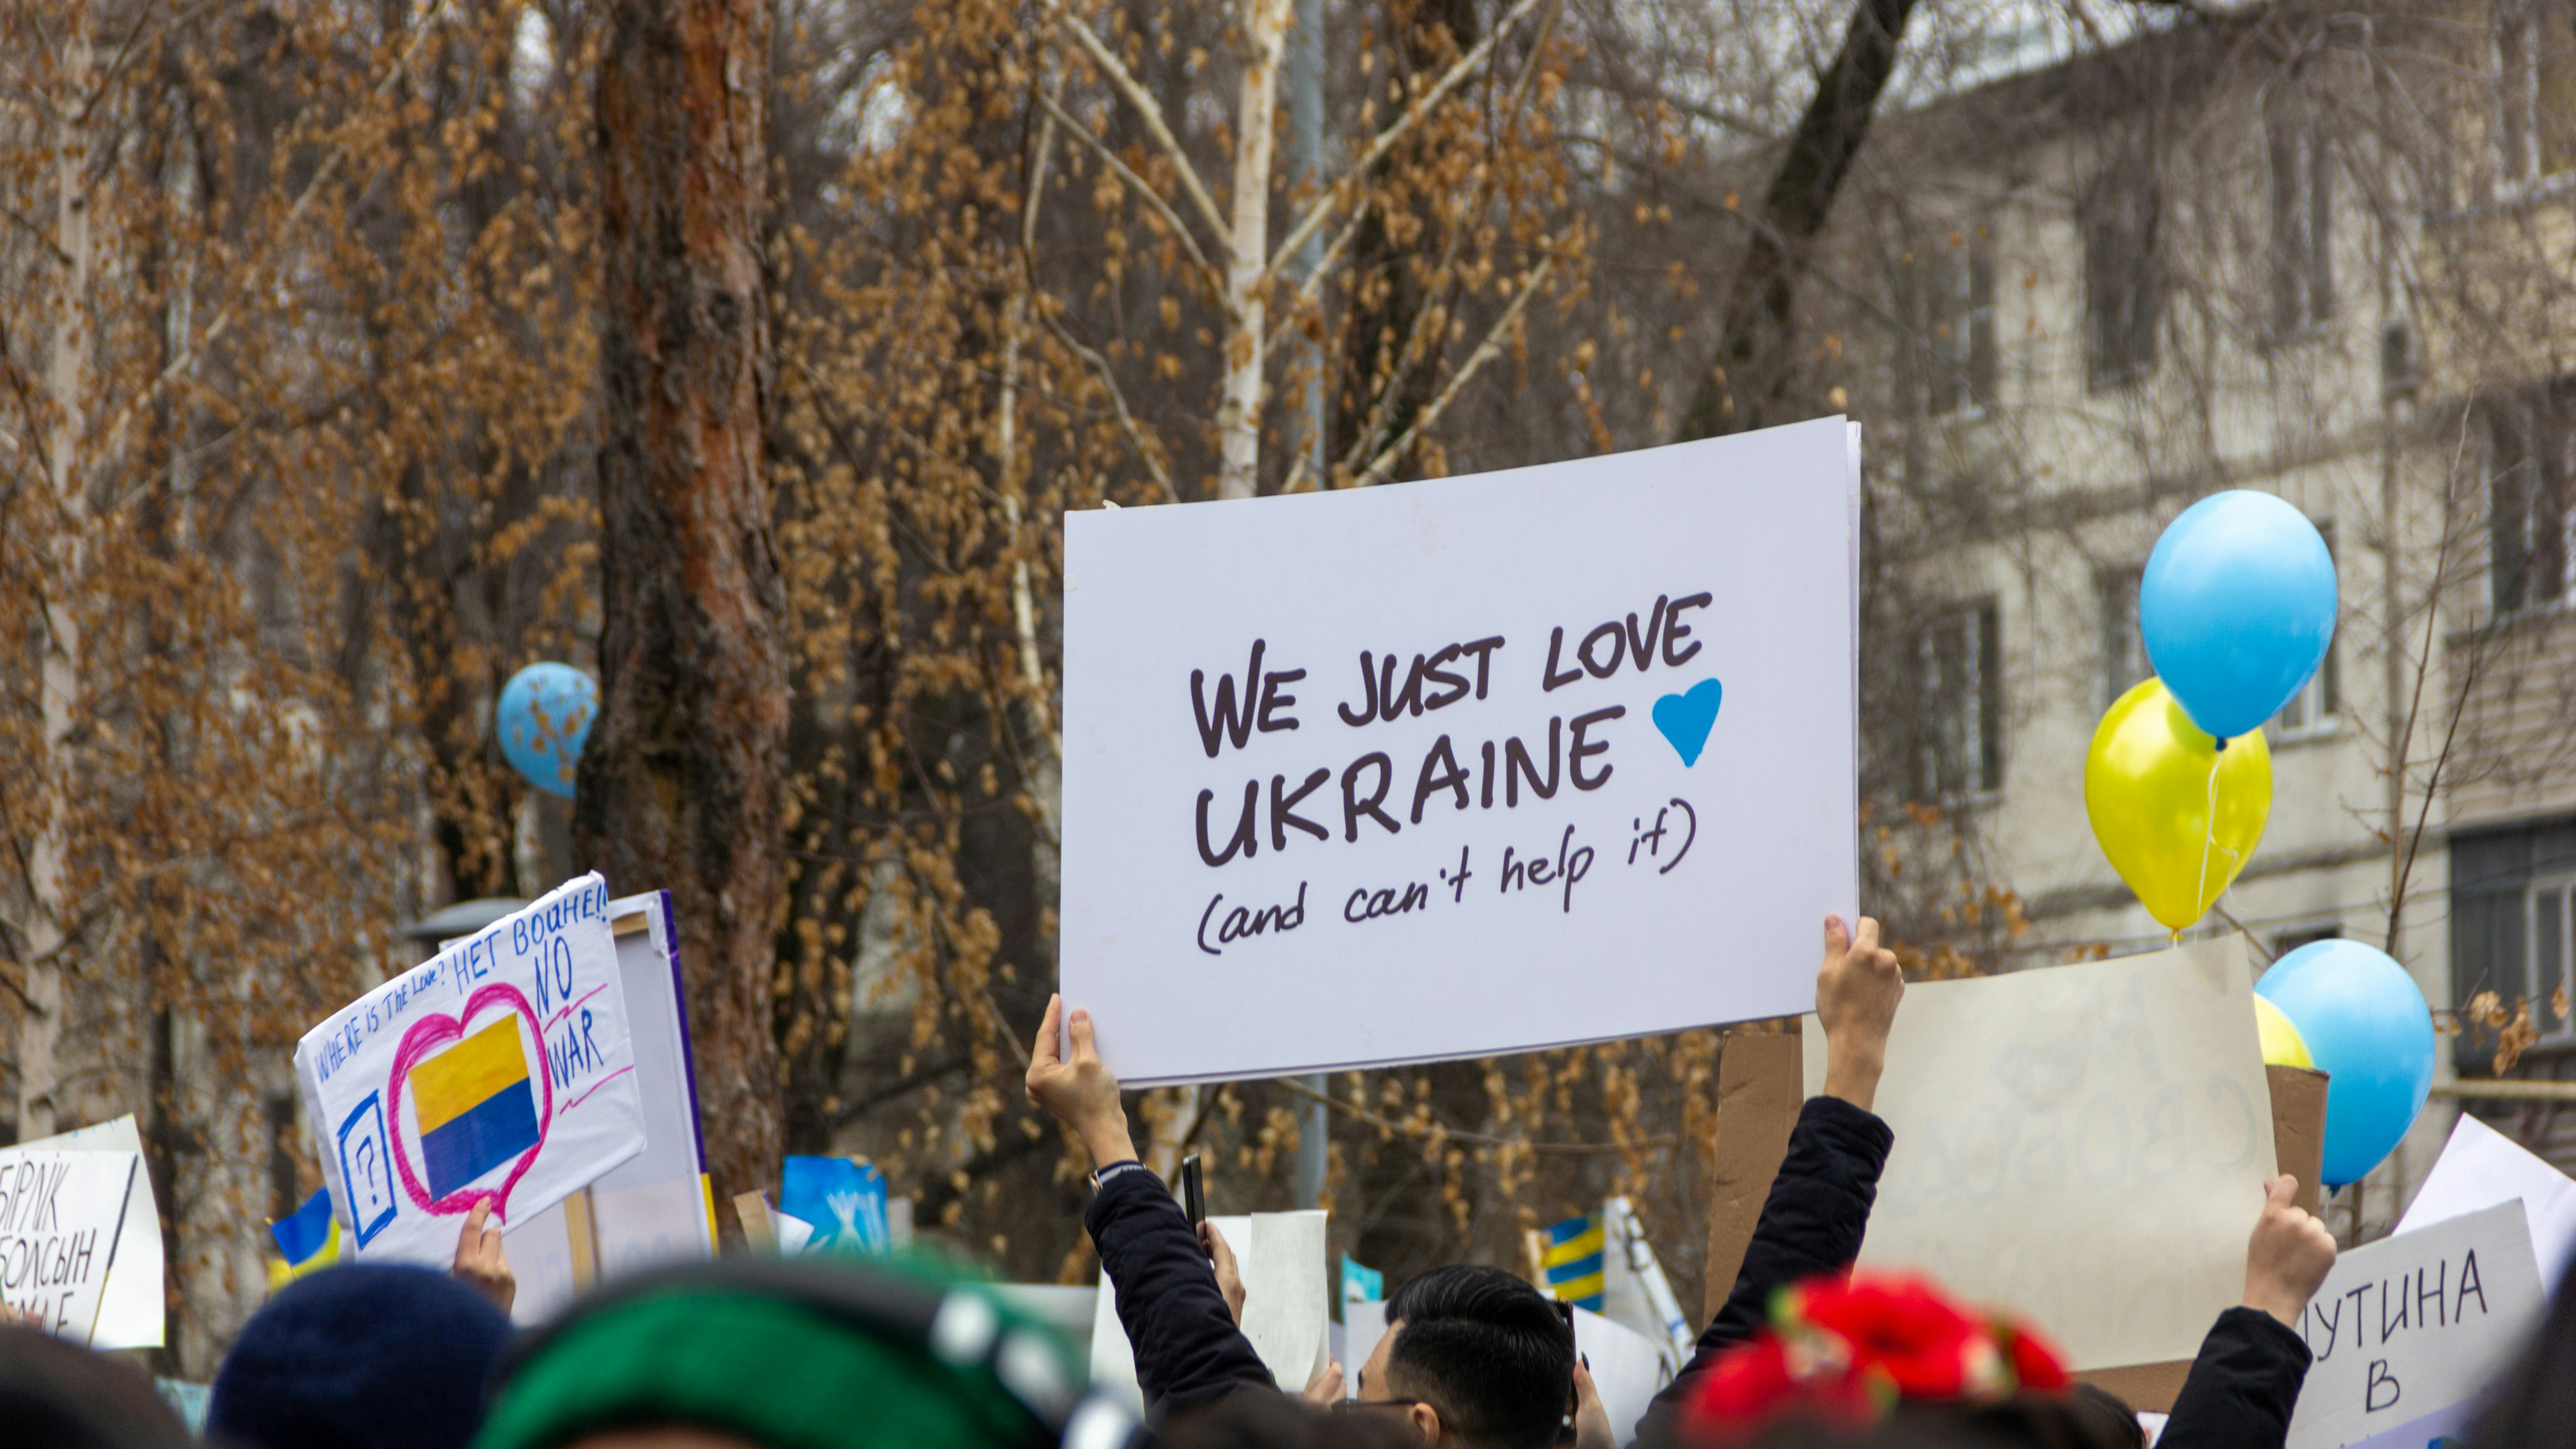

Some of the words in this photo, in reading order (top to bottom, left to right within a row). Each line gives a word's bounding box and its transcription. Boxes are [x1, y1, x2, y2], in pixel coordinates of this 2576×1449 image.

[1190, 638, 1307, 759] WE
[1337, 635, 1506, 728] JUST
[1542, 591, 1713, 693] LOVE
[1195, 704, 1626, 868] UKRAINE
[1197, 880, 1308, 956] (and
[1343, 845, 1473, 924] can't
[1500, 823, 1595, 914] help
[1627, 797, 1697, 875] it)
[453, 929, 502, 996] НЕТ
[534, 935, 572, 1020] NO
[315, 1015, 363, 1084] WHERE
[547, 1006, 604, 1090] WAR
[2365, 1358, 2401, 1414] В
